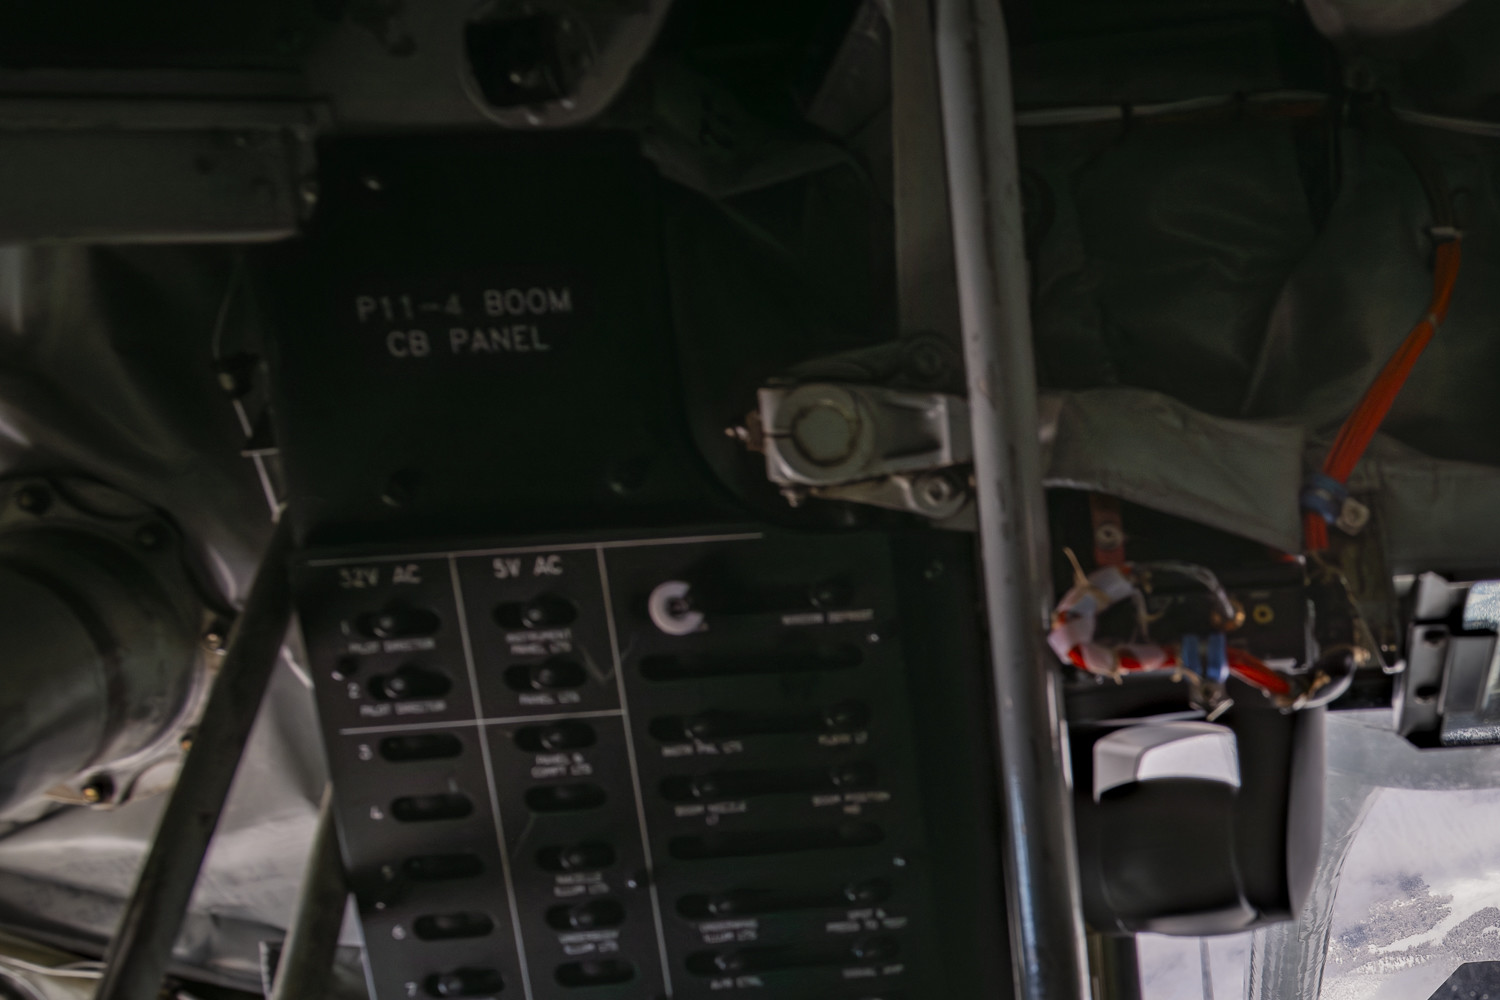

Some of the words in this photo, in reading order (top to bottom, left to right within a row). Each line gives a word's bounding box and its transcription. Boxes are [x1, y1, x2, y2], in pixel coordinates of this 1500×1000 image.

[355, 295, 462, 322] P11-4
[484, 287, 572, 317] BOOM
[386, 329, 431, 358] CB
[448, 324, 550, 354] PANEL
[392, 564, 422, 584] AC
[492, 557, 522, 578] 5V
[533, 554, 563, 575] AC
